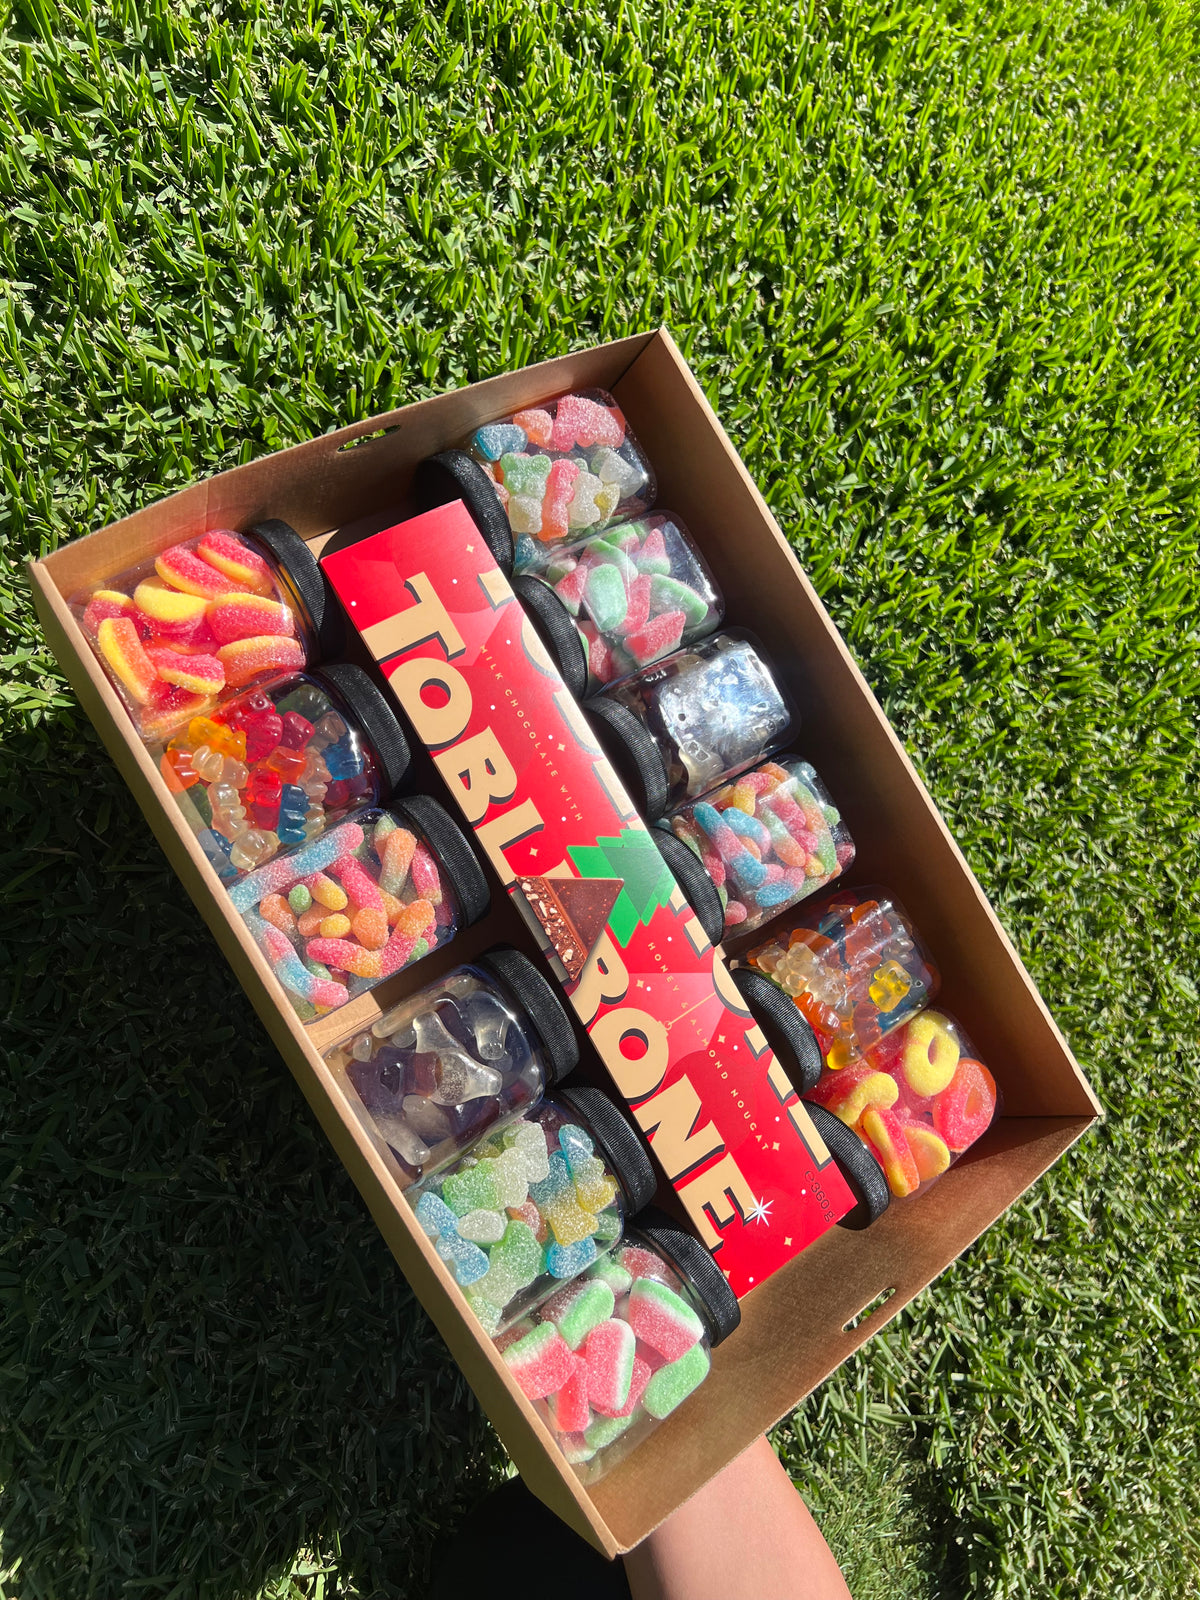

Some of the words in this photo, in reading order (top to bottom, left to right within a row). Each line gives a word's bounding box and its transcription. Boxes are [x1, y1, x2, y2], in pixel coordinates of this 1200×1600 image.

[480, 645, 504, 680] MILK
[504, 689, 559, 777] CHOCOLATE
[560, 785, 583, 822] WITH
[360, 571, 755, 1253] TOBLRONE
[647, 941, 680, 993] HONEY
[690, 1018, 728, 1081] ALMOND
[730, 1089, 769, 1152] NOUGAT
